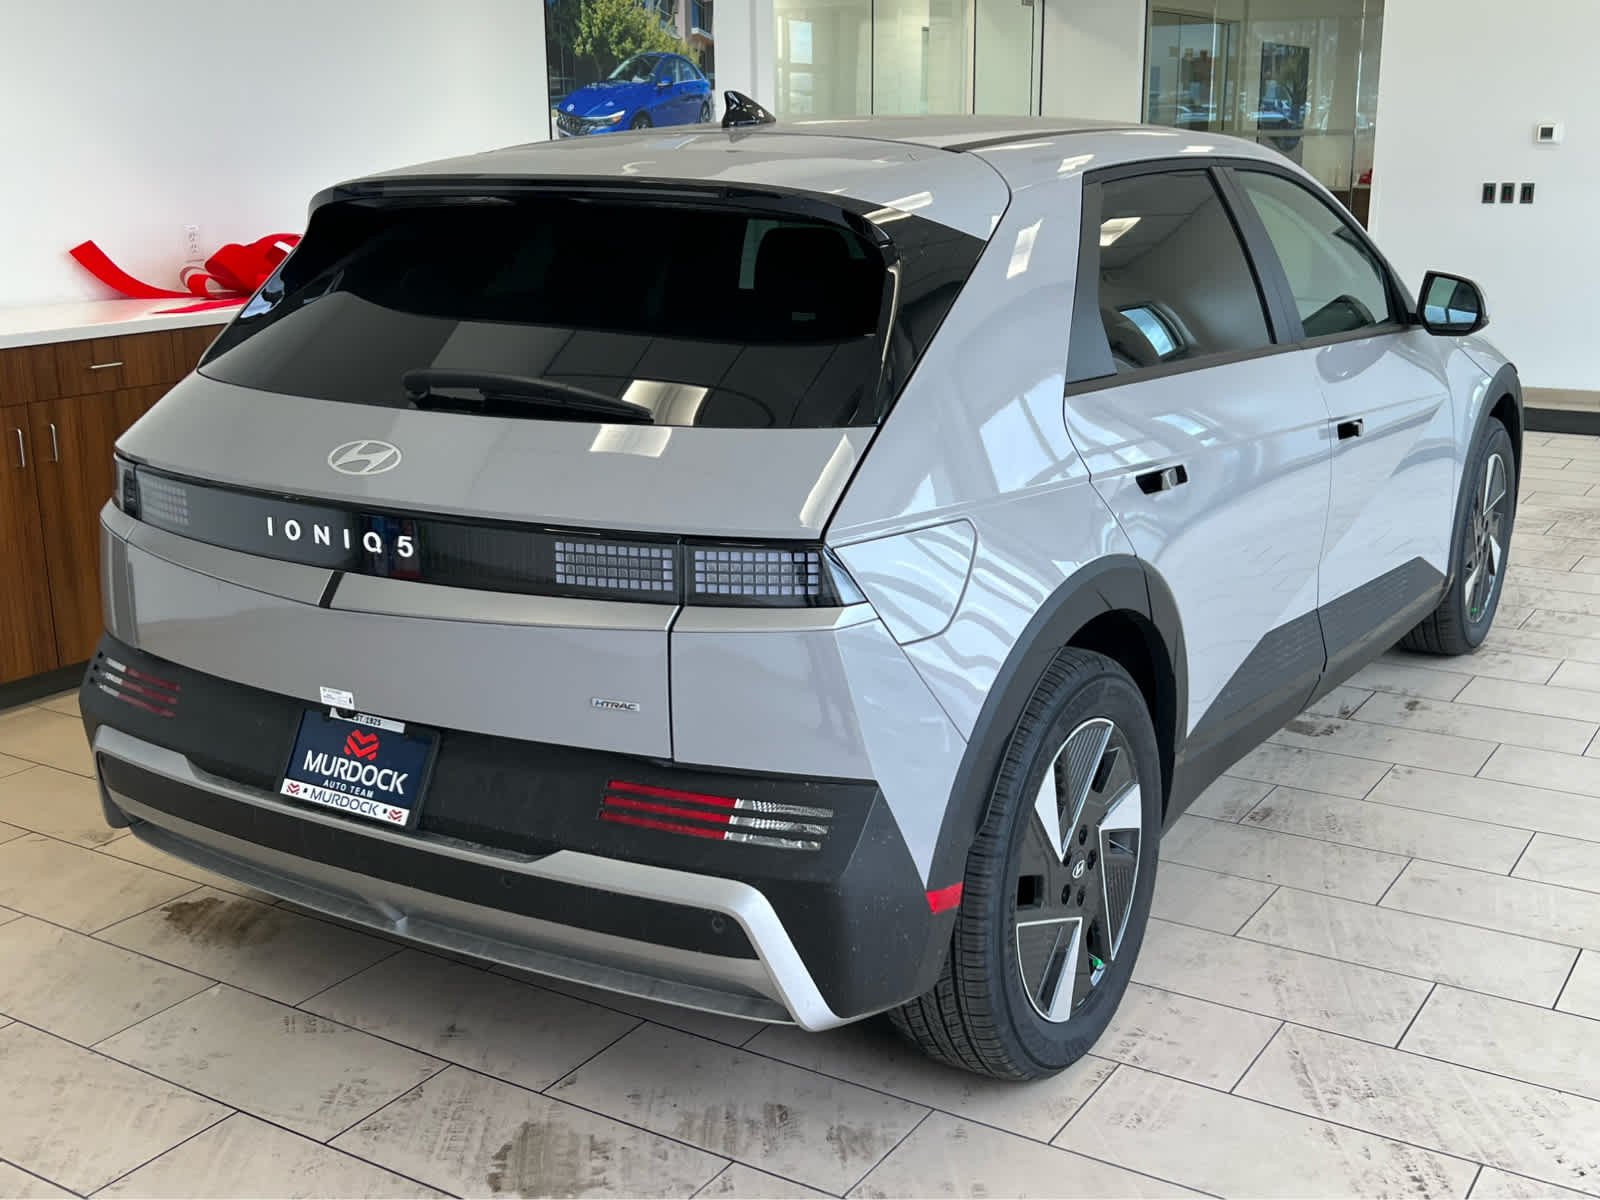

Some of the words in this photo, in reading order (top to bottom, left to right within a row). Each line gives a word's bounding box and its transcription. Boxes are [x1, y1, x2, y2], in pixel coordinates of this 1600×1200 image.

[267, 517, 382, 554] IONIQ
[397, 535, 414, 558] 5
[303, 750, 408, 795] MURDOCK
[322, 779, 347, 792] AUTO
[350, 785, 375, 798] TEAM
[310, 787, 380, 816] MURDOCK
